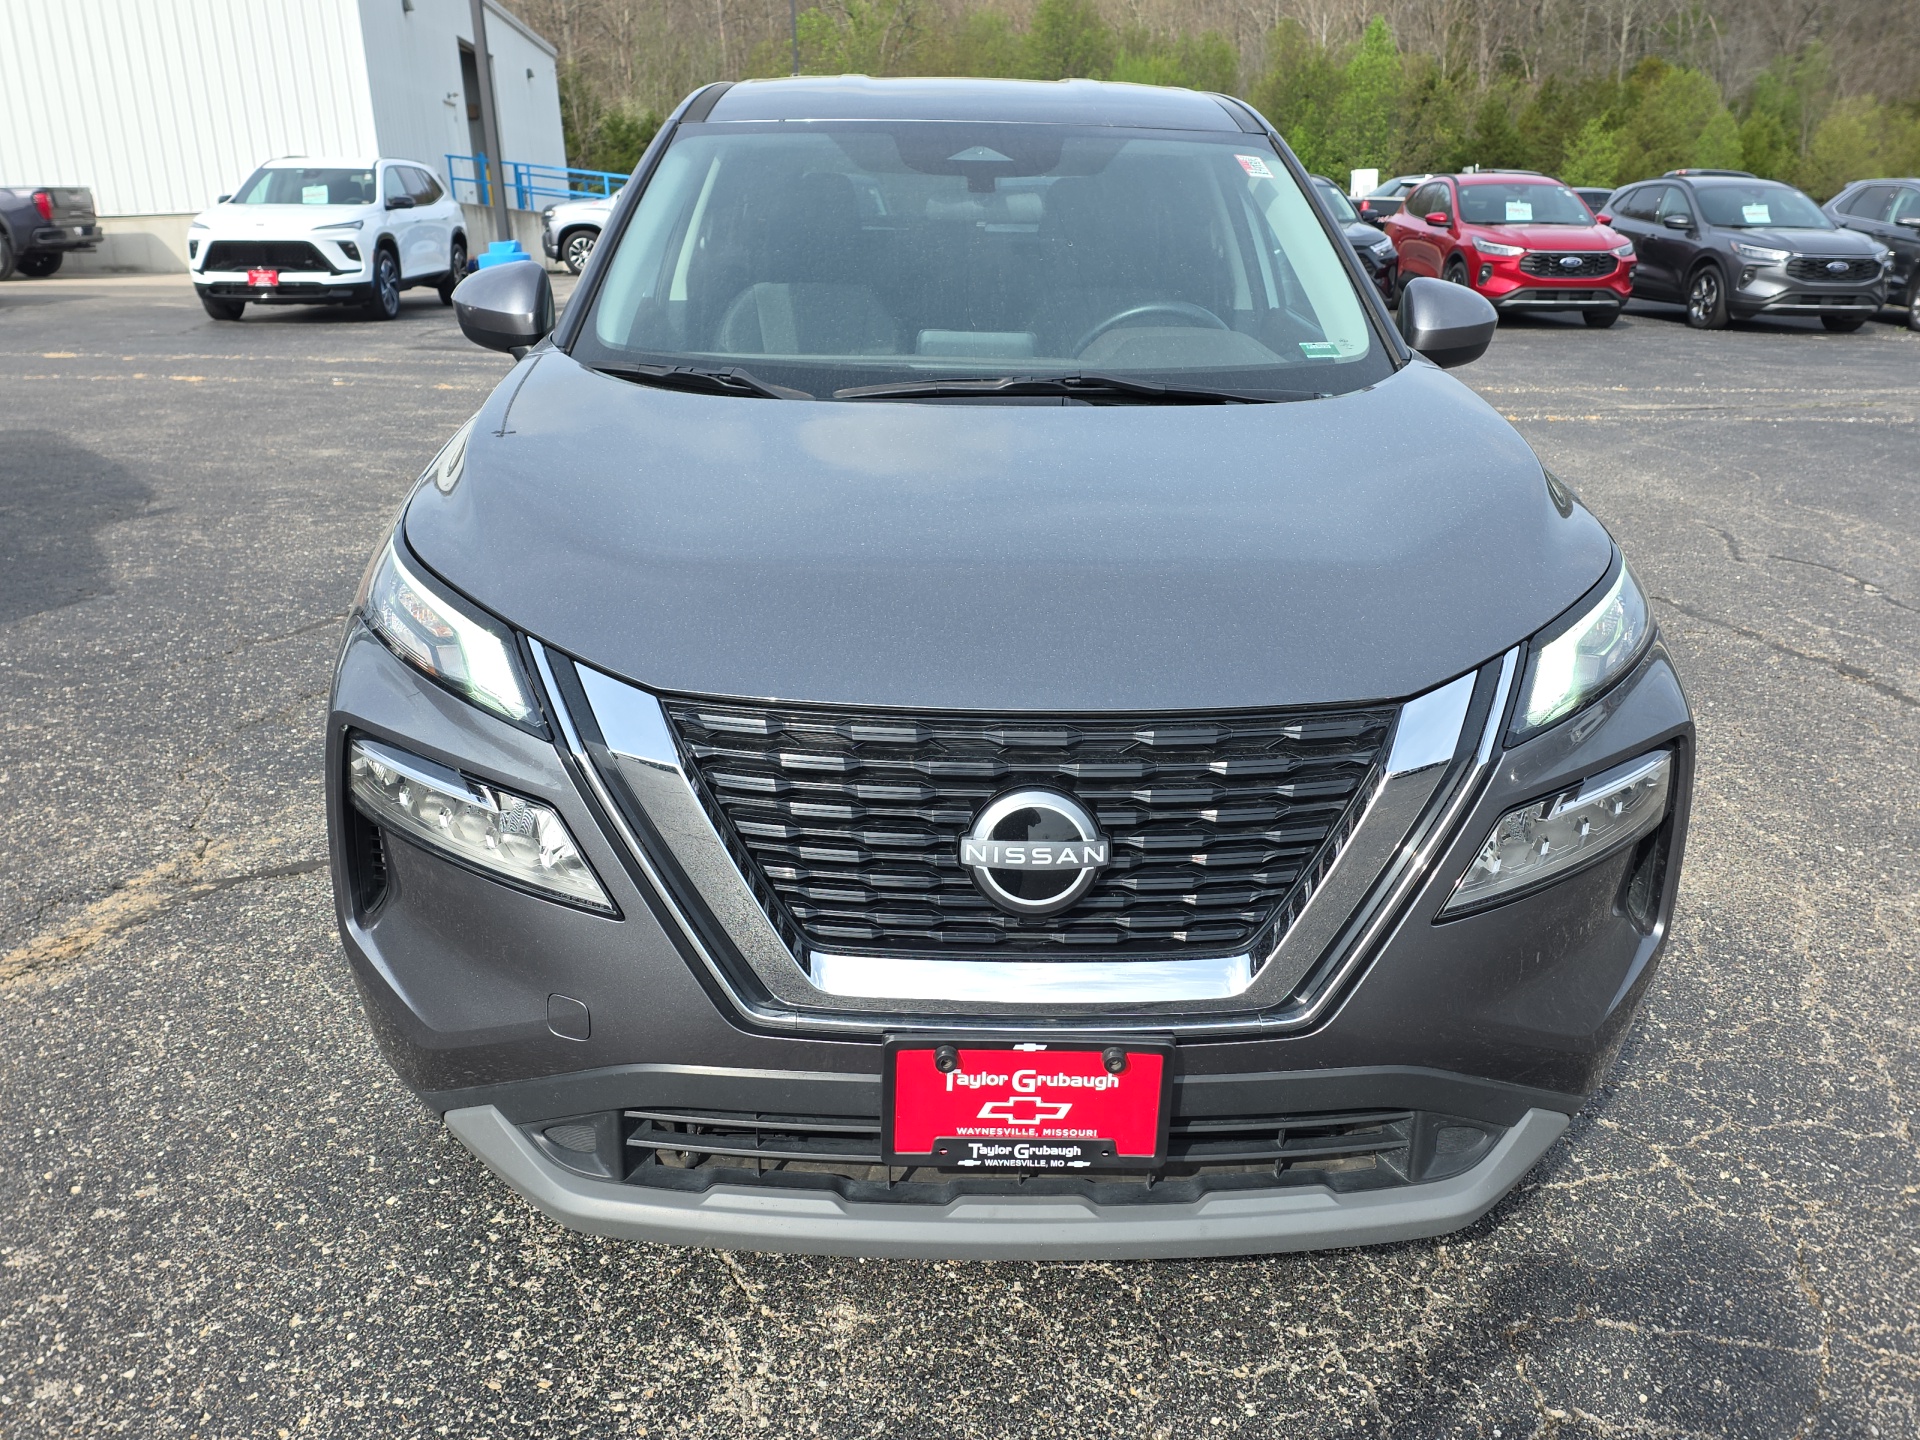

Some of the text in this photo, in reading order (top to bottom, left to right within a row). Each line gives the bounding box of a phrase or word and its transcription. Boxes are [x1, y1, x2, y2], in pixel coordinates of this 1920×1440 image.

[965, 844, 1104, 865] NISSAN
[946, 1069, 1118, 1092] Taylor Grubaugh
[957, 1128, 1038, 1136] WAYNESVILLE,
[968, 1143, 1081, 1159] Taylor Grubaugh
[985, 1159, 1065, 1168] WAYNESVILLE, MO
